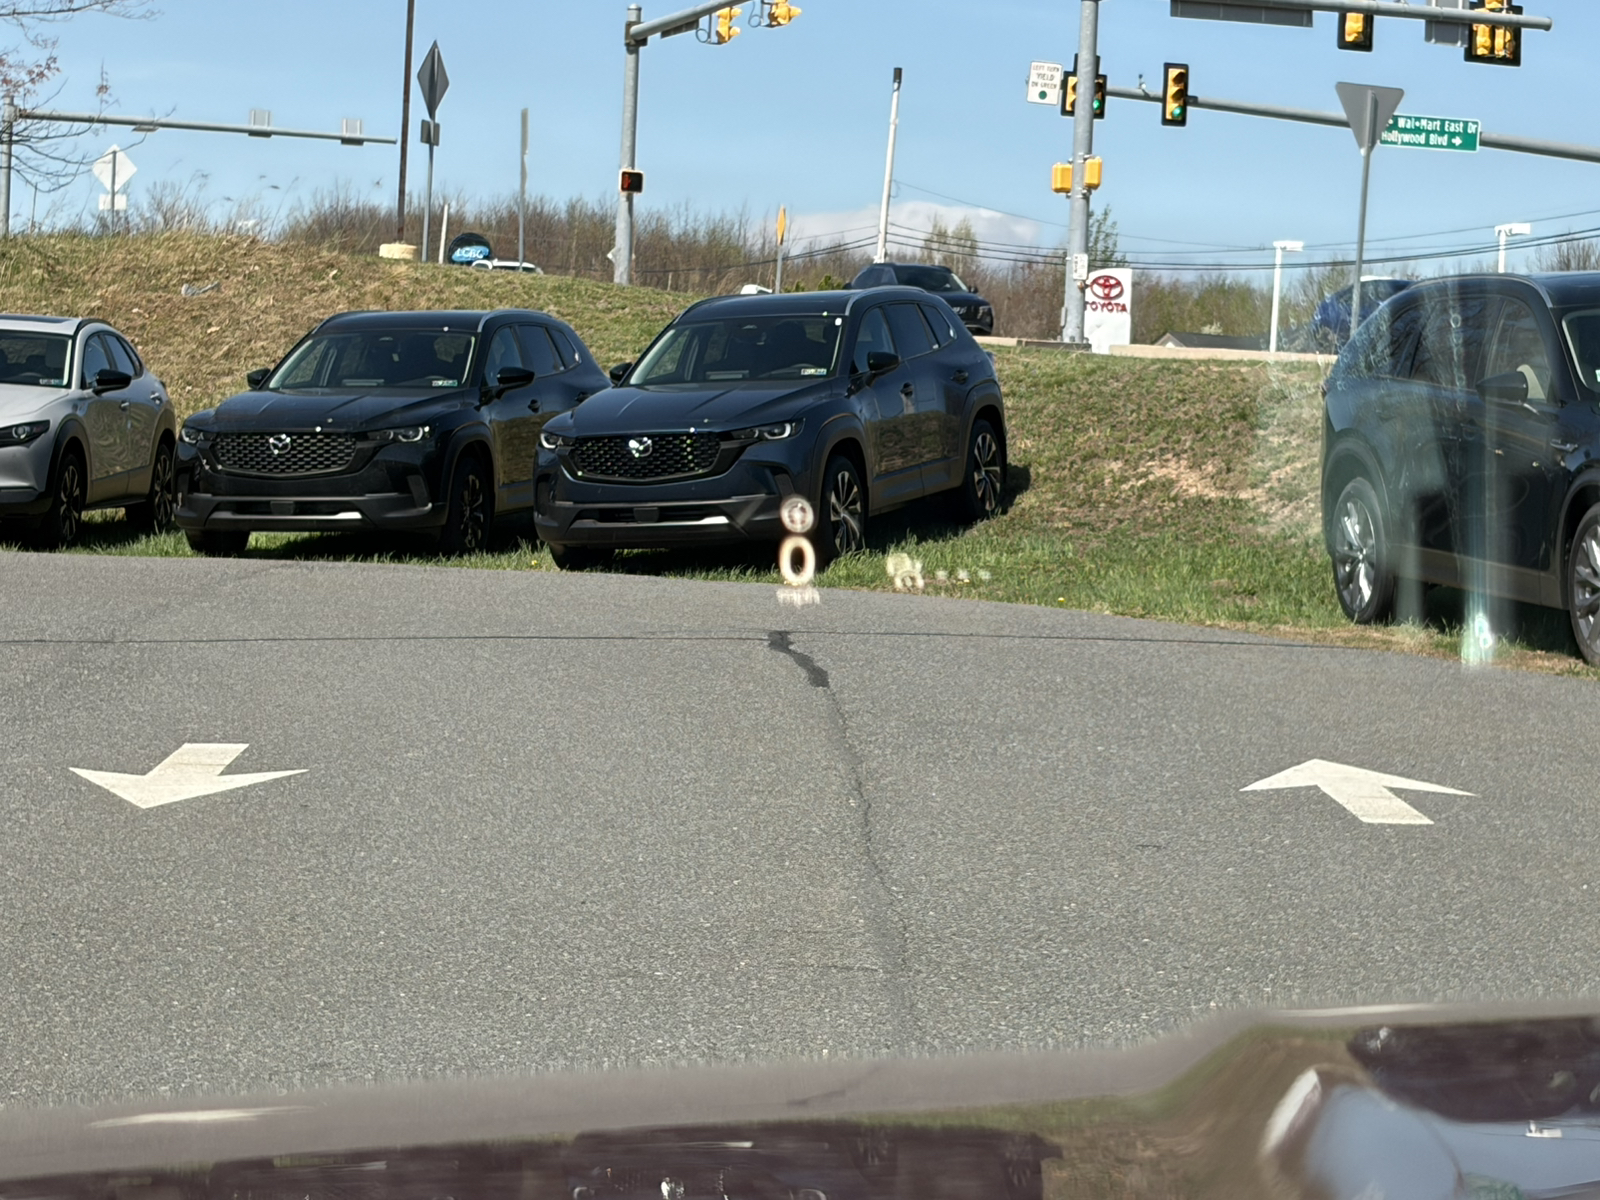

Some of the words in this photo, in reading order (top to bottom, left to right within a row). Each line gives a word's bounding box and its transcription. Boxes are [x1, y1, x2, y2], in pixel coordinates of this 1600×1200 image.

[1036, 72, 1055, 82] YIELD
[1444, 120, 1464, 134] East
[1466, 121, 1478, 135] Dr
[1381, 129, 1426, 146] Hollywood
[1428, 132, 1449, 147] Blvd
[1085, 300, 1127, 313] TOYOTA
